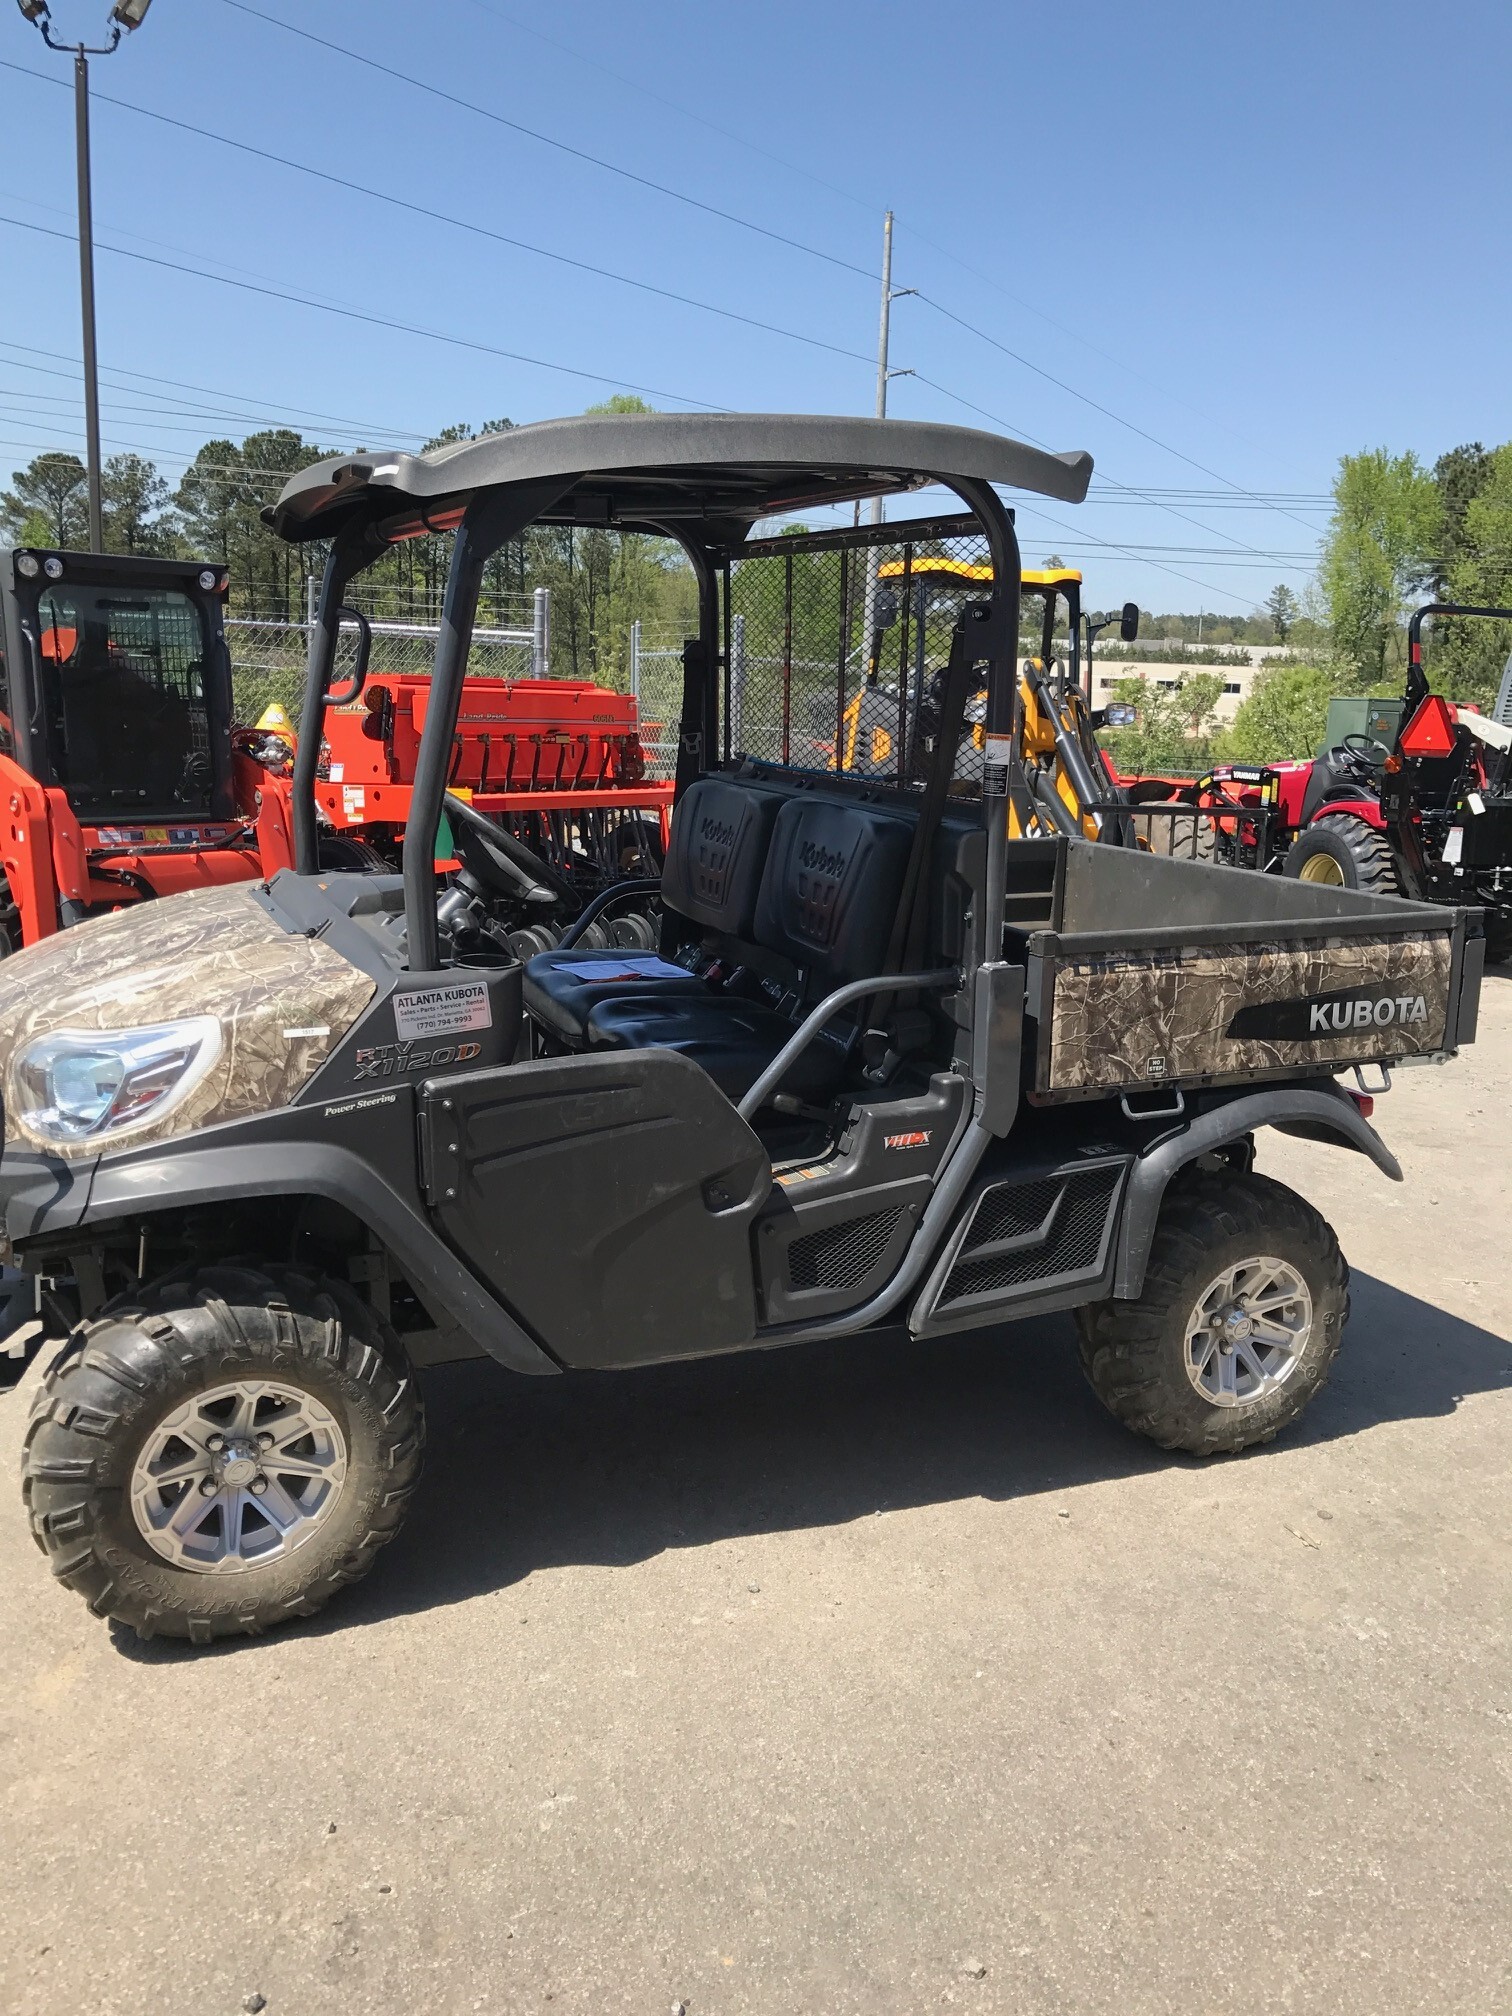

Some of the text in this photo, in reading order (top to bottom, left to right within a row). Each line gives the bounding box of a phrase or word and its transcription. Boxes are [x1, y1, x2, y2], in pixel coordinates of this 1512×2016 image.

[1232, 770, 1261, 781] YANMAR
[1071, 953, 1198, 977] DIESEL
[397, 986, 485, 1009] ATLANTA KUBOTA
[400, 998, 485, 1017] Sales Parts Service Rental
[416, 1015, 473, 1031] (770) 794-9993
[1309, 995, 1429, 1032] KUBOTA
[353, 1042, 481, 1081] X1120D
[355, 1041, 415, 1063] RTV
[324, 1094, 397, 1117] Power Steering
[883, 1130, 934, 1151] VHT-X
[188, 1596, 261, 1615] OFF
